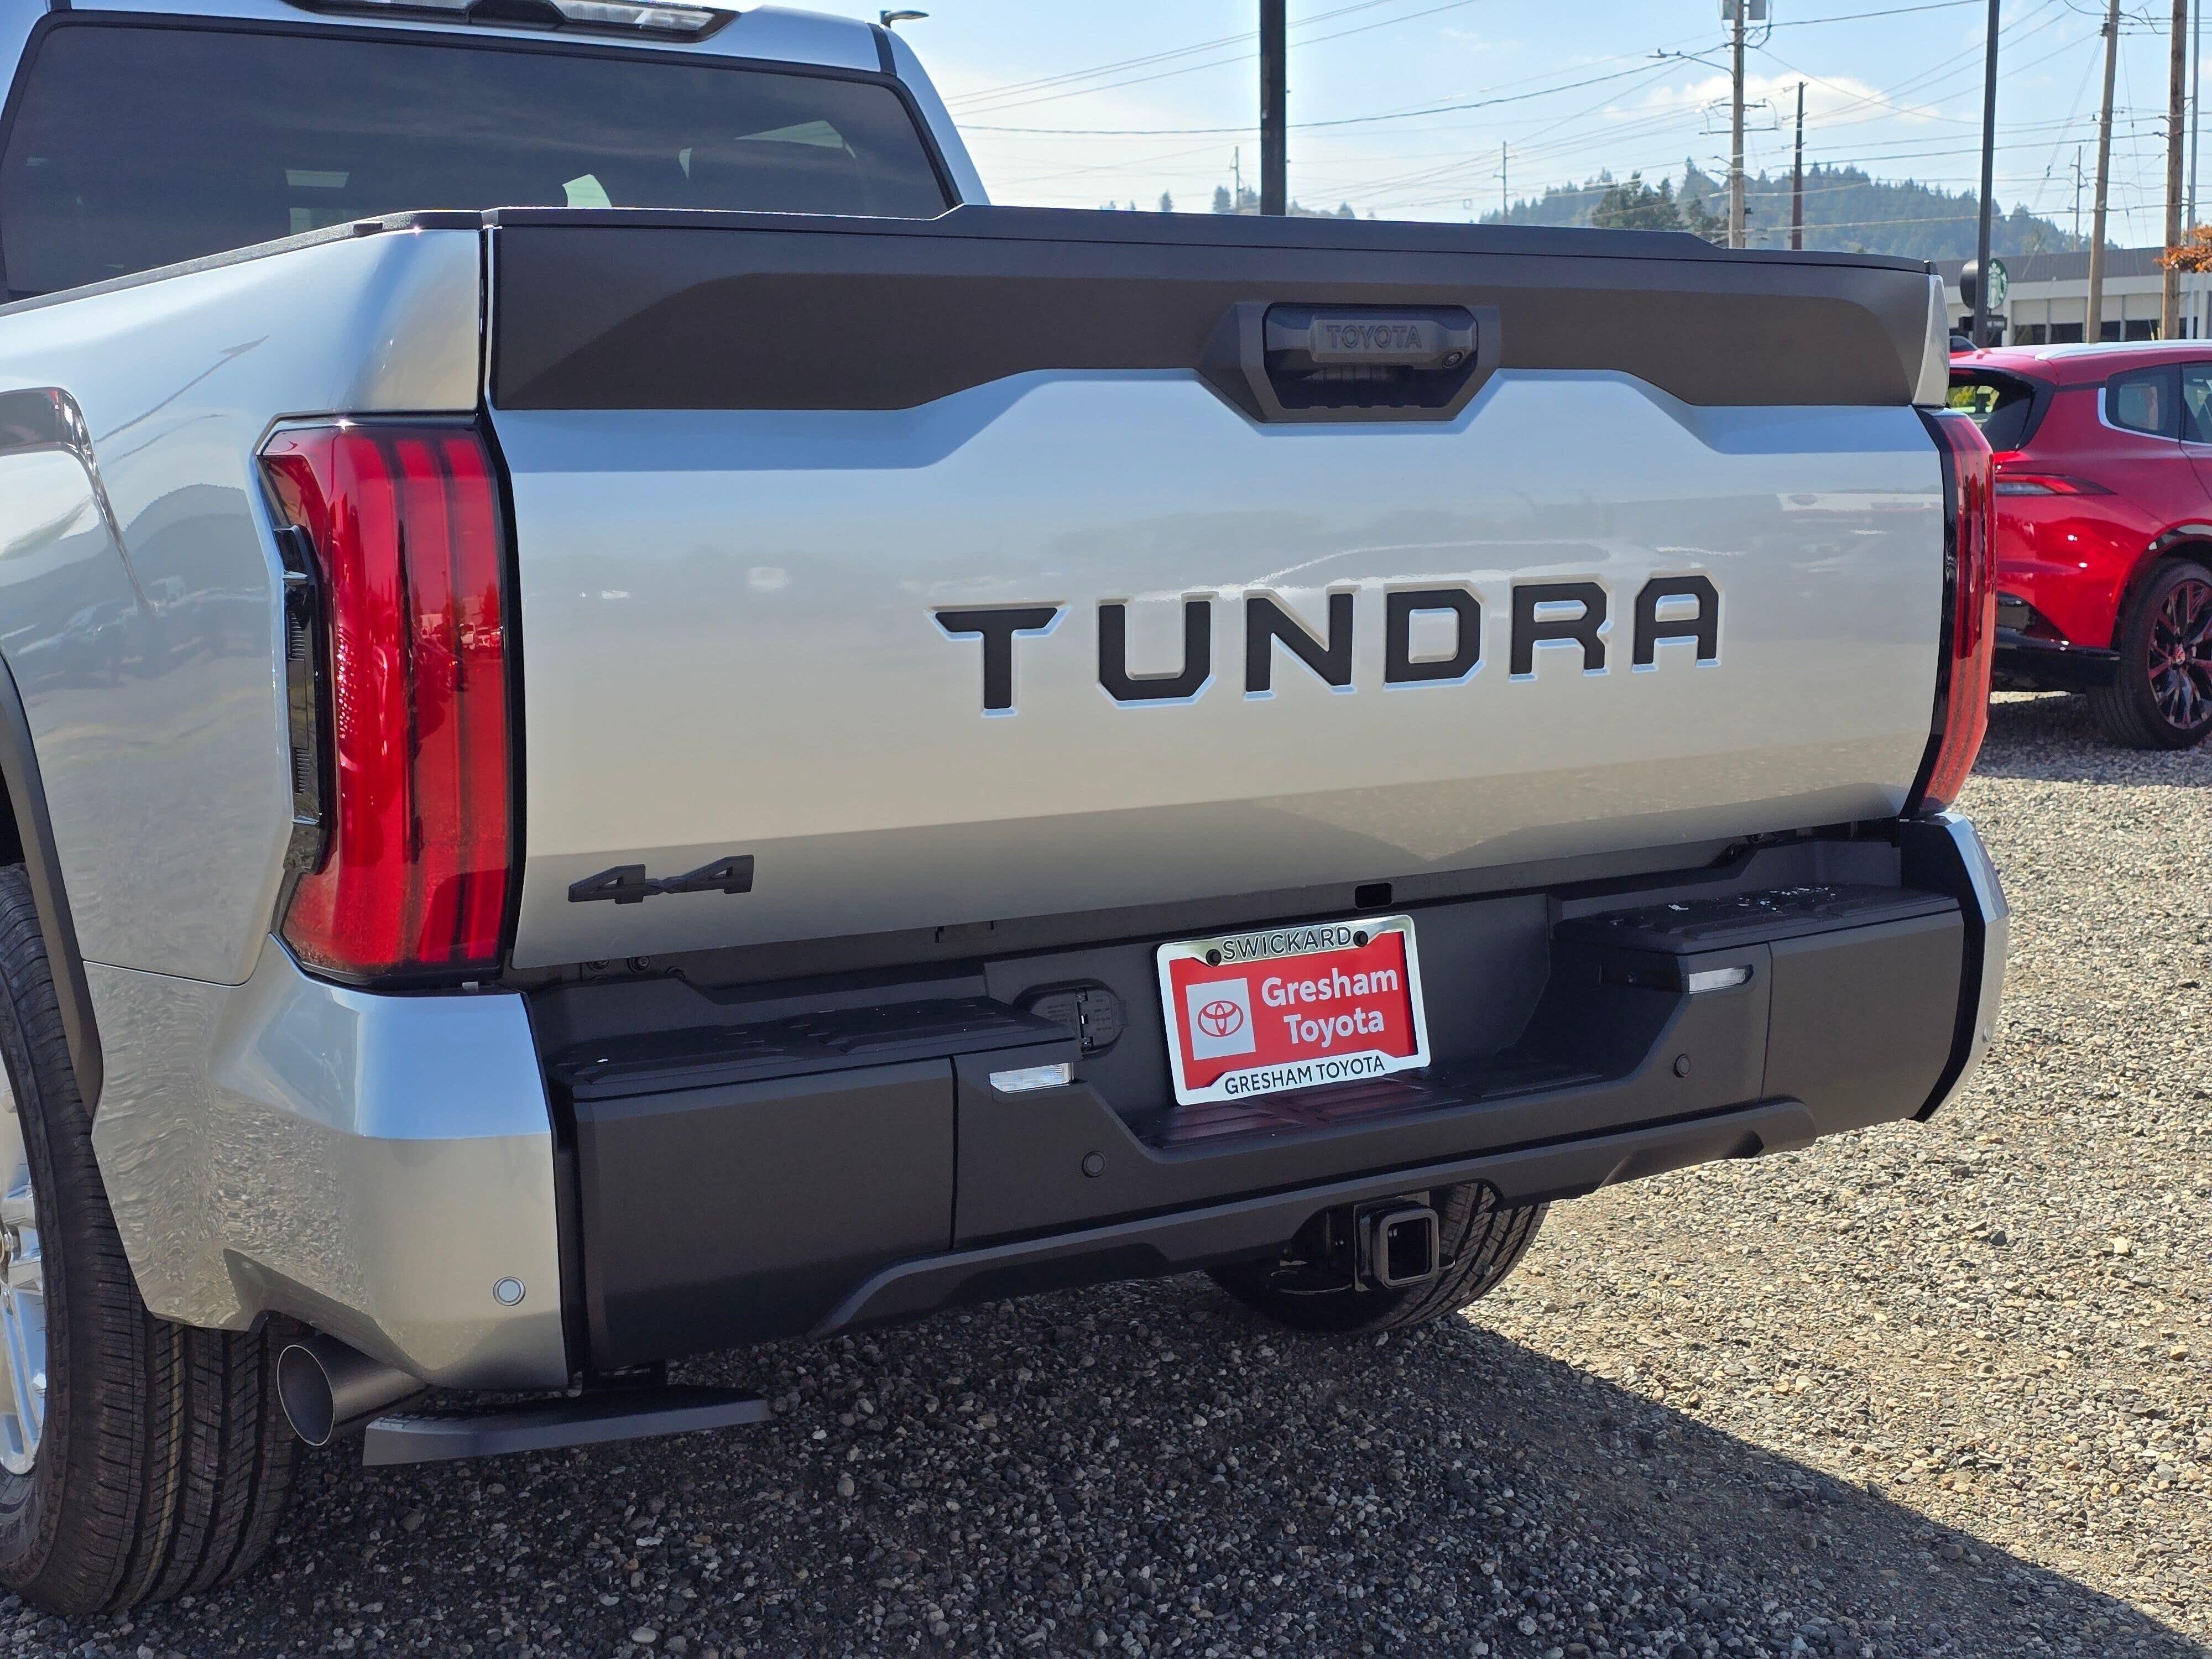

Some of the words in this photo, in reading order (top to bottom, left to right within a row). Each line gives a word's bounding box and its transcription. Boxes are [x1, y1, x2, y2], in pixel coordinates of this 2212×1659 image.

[1326, 324, 1423, 349] TOYOTA
[932, 572, 1722, 713] TUNDRA
[1222, 926, 1352, 961] SWICKARD
[1261, 967, 1399, 1008] Gresham
[1283, 1007, 1385, 1048] Toyota
[1224, 1066, 1312, 1095] GRESHAM
[1316, 1055, 1385, 1080] TOYOTA
